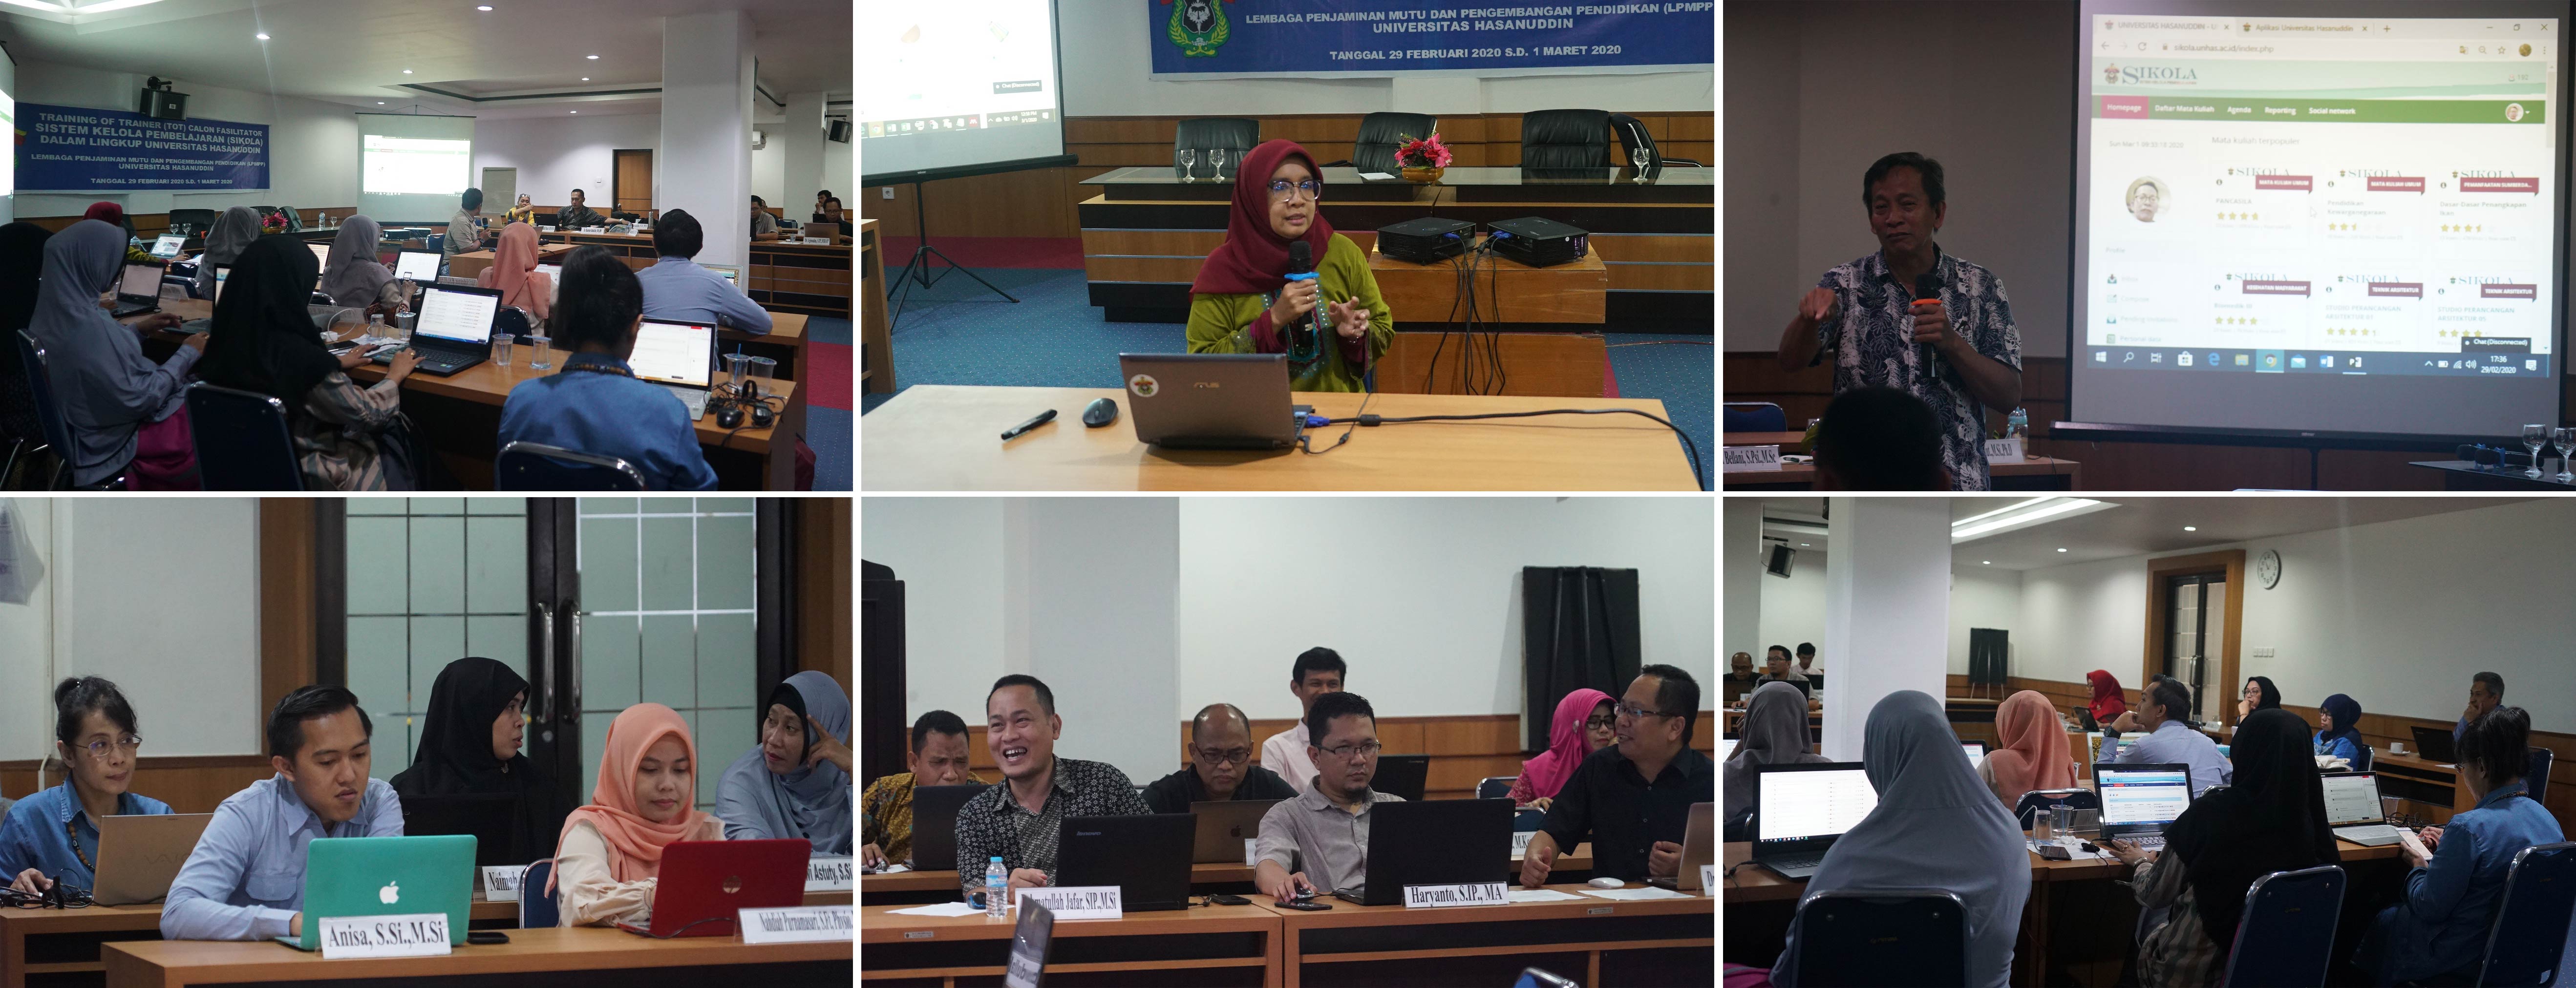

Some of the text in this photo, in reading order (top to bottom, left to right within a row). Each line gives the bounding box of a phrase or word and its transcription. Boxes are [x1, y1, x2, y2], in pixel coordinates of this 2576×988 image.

[1246, 14, 1303, 23] LEMBAGA
[1306, 11, 1385, 22] PENJAMINAN
[1389, 10, 1426, 20] MUTU
[1431, 8, 1457, 19] DAN
[1461, 6, 1573, 18] PENGEMBANGAN
[1576, 3, 1659, 15] PENDIDIKAN
[1373, 18, 1573, 33] UNIVERSITAS HASANUDDIN
[2160, 22, 2205, 30] HASANUDDIN
[1330, 45, 1621, 60] TANGGAL 29 FEBRUARI 2020 S.D. 1 MARET 2020
[2122, 65, 2197, 84] SIKOLA
[2108, 104, 2142, 112] Homepage
[2227, 106, 2252, 115] Agenda
[2265, 106, 2296, 116] Reporting
[40, 113, 97, 124] TRAINING
[119, 119, 161, 129] TRAINER
[164, 123, 186, 132] (TOT)
[217, 128, 262, 136] FASILITATOR
[36, 123, 263, 147] SISTEM KELOLA PEMBELAJARAN (SIKOLA)
[41, 135, 260, 153] DALAM LINGKUP UNIVERSITAS HASANUDDIN
[2259, 137, 2300, 146] terpopuler
[1724, 450, 1746, 467] Bellani,
[489, 871, 519, 891] Naimah
[814, 864, 839, 885] Astuty,
[1066, 892, 1085, 913] Jafar,
[1411, 886, 1458, 907] Haryanto,
[1485, 884, 1503, 901] MA
[759, 912, 784, 932] Nahdiah
[783, 911, 822, 935] Purnamasari,
[329, 921, 444, 950] Anisa, S.Si.,M.Si
